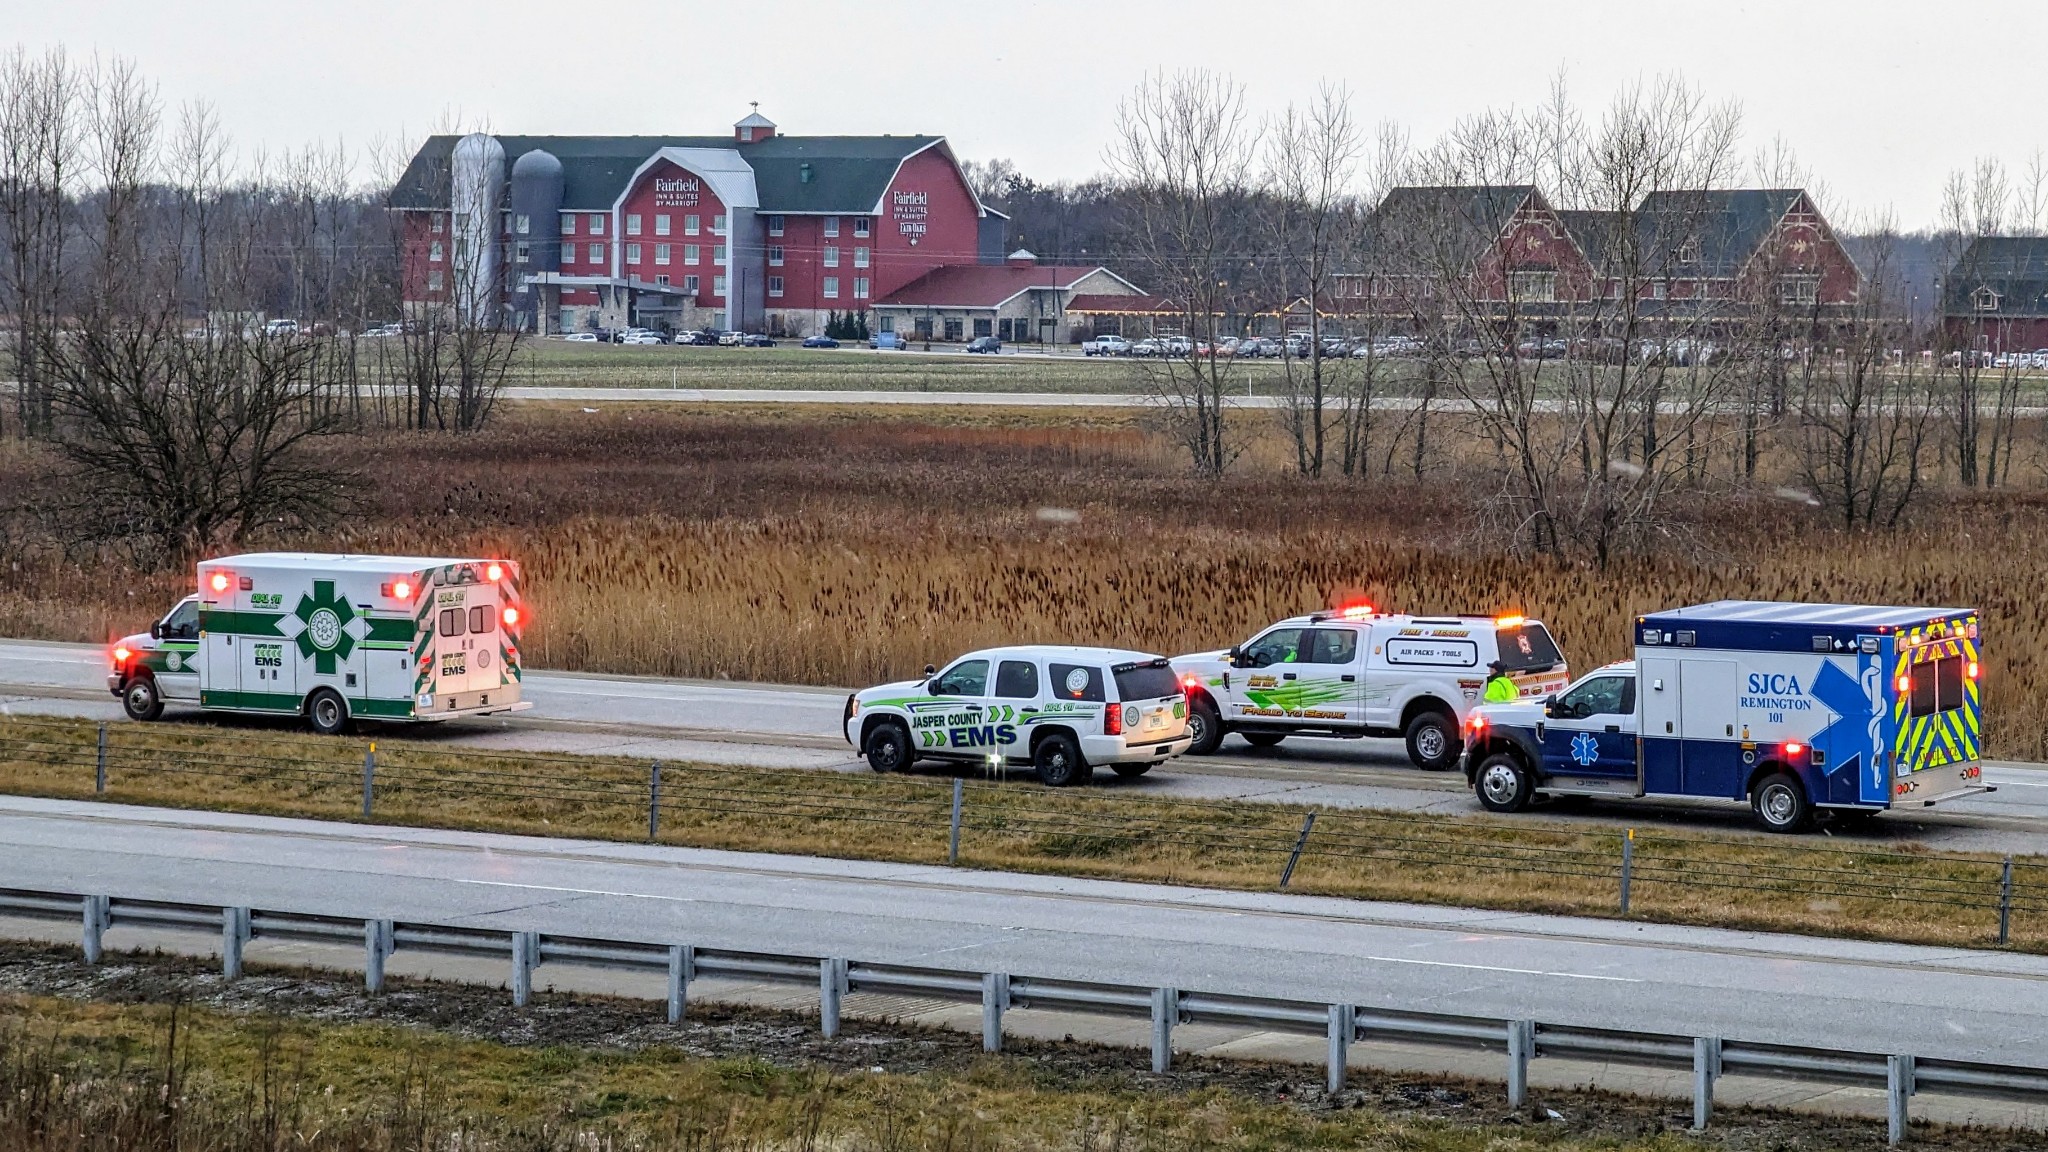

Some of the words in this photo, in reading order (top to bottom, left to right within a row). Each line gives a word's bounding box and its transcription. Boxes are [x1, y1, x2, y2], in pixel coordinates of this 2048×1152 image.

[656, 178, 699, 191] Fairfield
[894, 191, 927, 205] Fairfield
[255, 656, 282, 667] EMS
[442, 665, 466, 677] EMS
[1748, 673, 1803, 696] SJCA
[1740, 697, 1811, 710] REMINGTON
[1242, 706, 1284, 717] PROUD
[1286, 709, 1302, 718] TO
[1303, 709, 1347, 720] SERVE
[1769, 712, 1783, 723] 101
[912, 714, 946, 729] JASPER
[947, 711, 983, 726] COUNTY
[948, 724, 1018, 748] EMS
